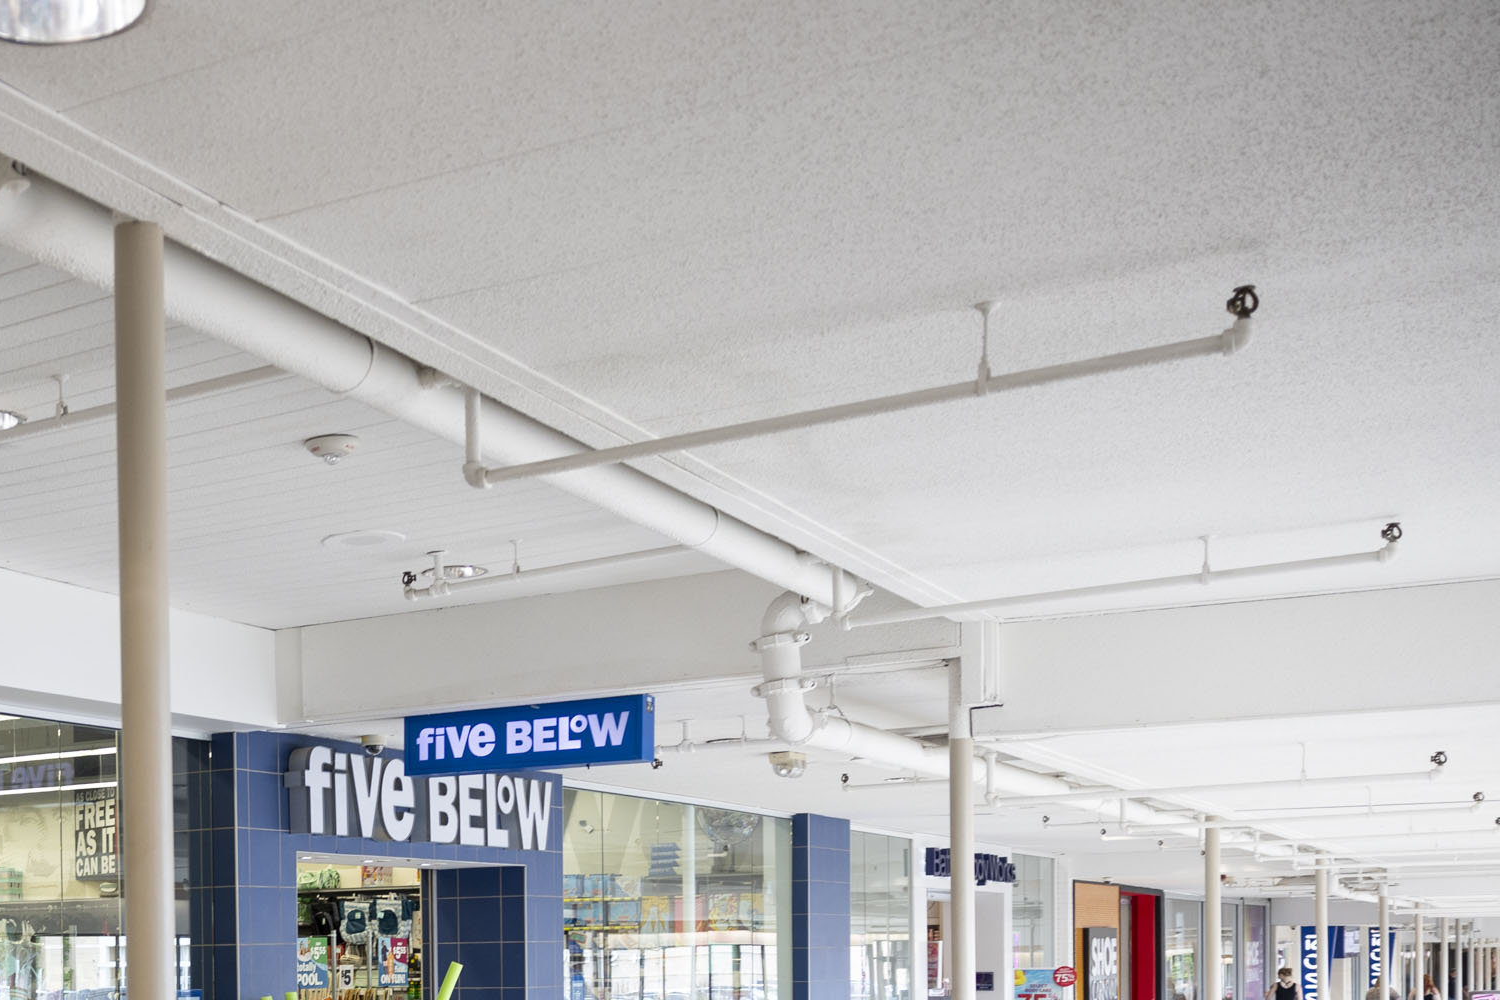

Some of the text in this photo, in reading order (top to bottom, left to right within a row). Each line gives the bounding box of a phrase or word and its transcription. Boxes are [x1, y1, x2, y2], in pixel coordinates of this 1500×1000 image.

[417, 711, 630, 761] five BELOW
[85, 789, 106, 801] CLOSE
[304, 745, 552, 851] five BELOW
[75, 798, 116, 830] FREE
[76, 827, 116, 857] AS IT
[76, 855, 116, 877] CAN BE
[1092, 937, 1117, 976] SHOE
[341, 969, 352, 986] $5
